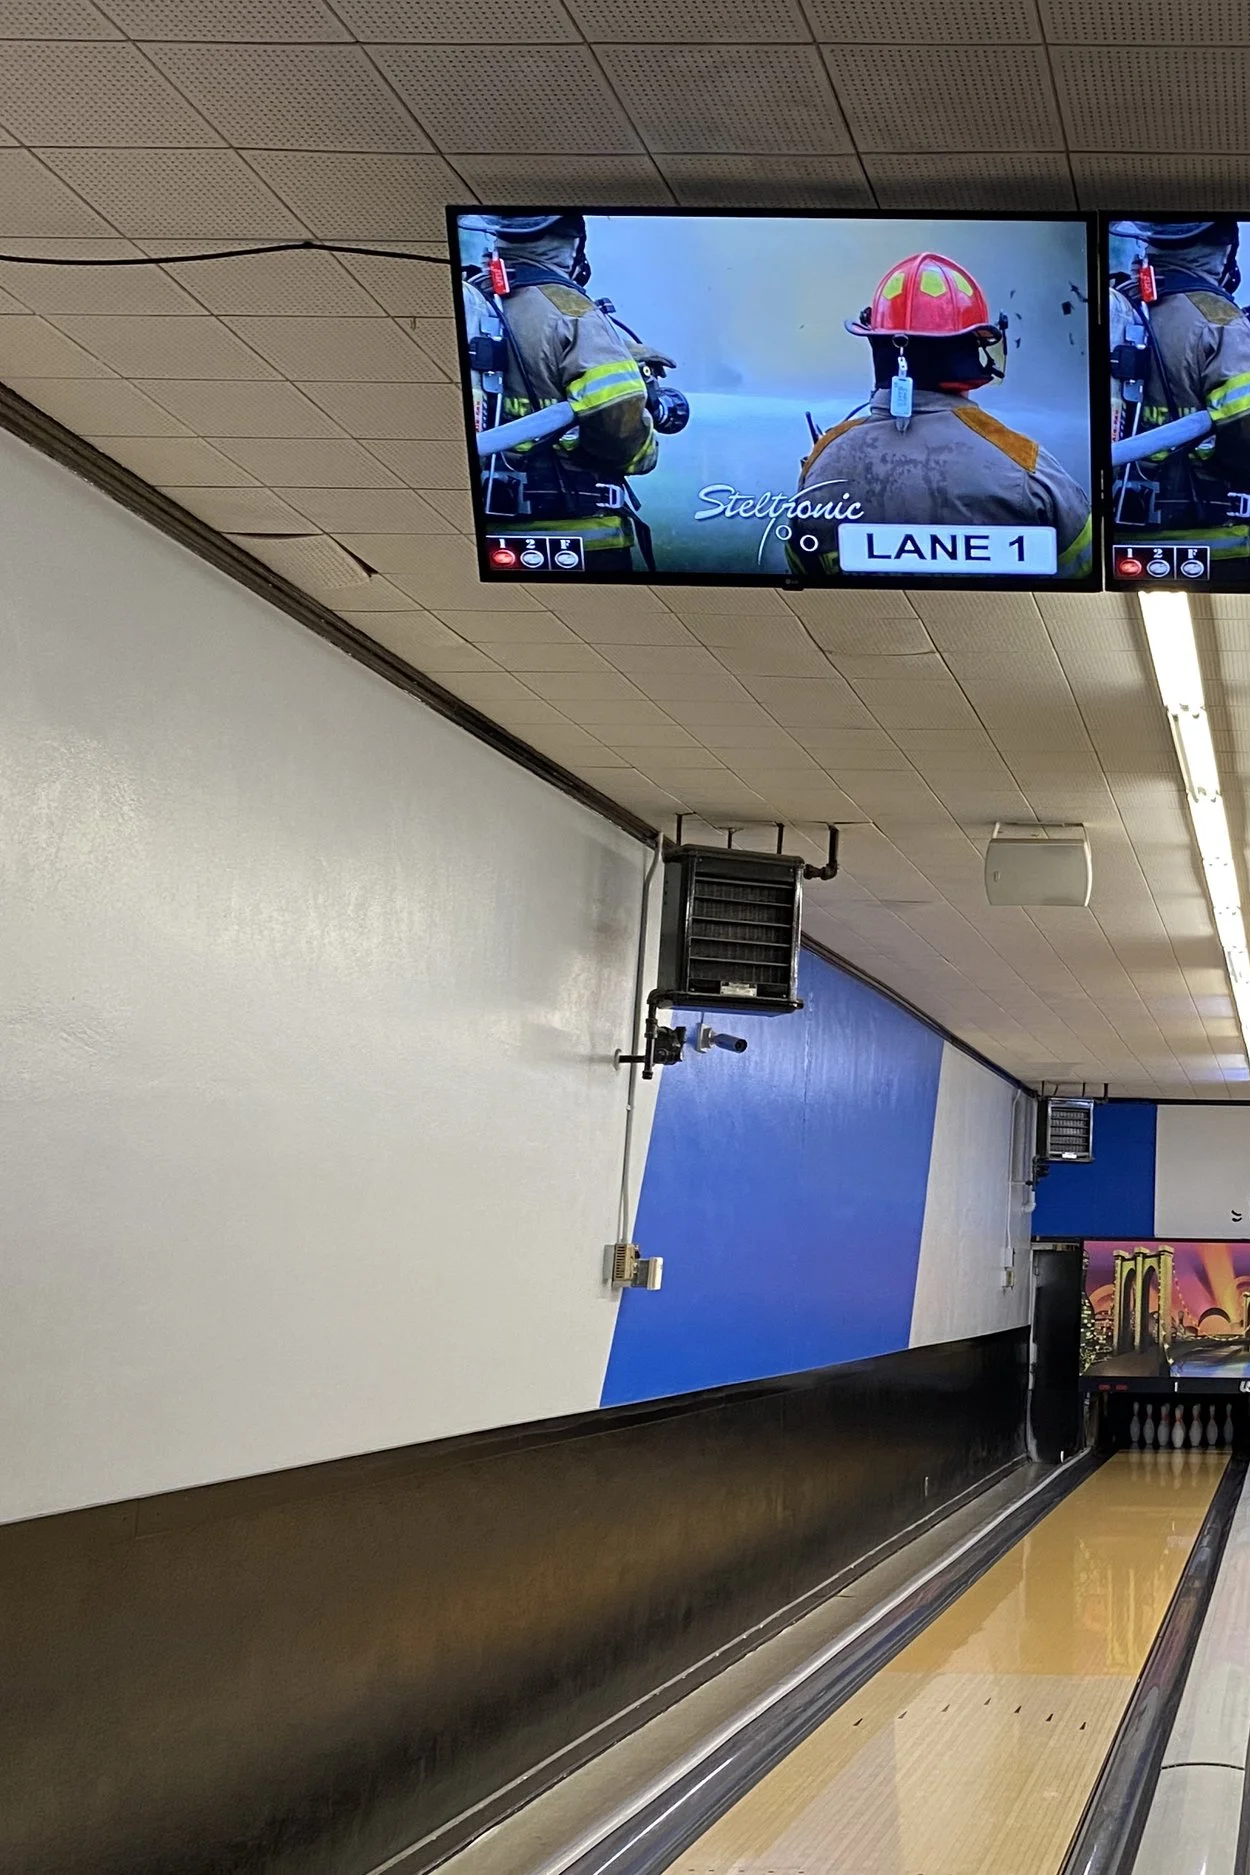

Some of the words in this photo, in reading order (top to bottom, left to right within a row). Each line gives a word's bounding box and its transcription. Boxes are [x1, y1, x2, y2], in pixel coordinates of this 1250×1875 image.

[695, 480, 864, 527] Steltronic
[499, 538, 507, 548] 1
[525, 539, 536, 548] 2
[560, 539, 571, 549] F
[866, 533, 990, 561] LANE
[1008, 535, 1025, 562] 1
[1126, 548, 1134, 558] 1
[1153, 548, 1163, 558] 2
[1187, 549, 1198, 559] F
[1174, 1381, 1179, 1392] 1
